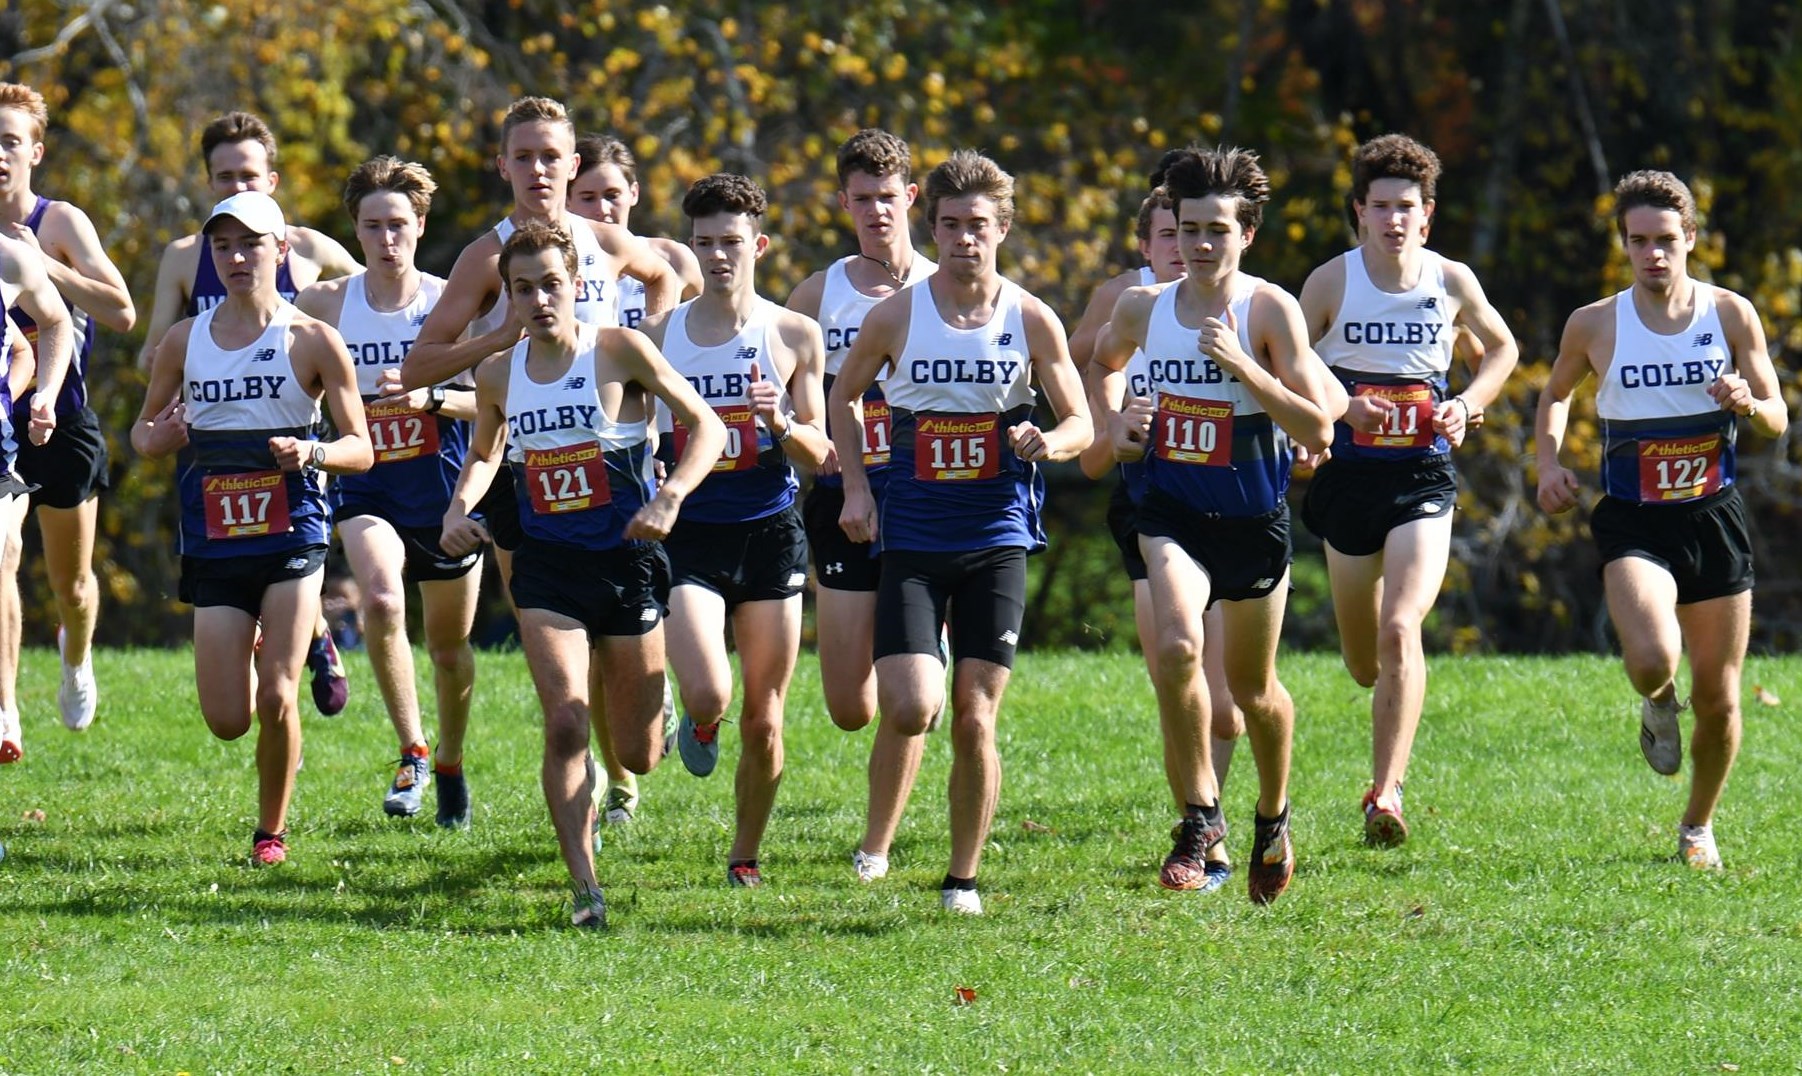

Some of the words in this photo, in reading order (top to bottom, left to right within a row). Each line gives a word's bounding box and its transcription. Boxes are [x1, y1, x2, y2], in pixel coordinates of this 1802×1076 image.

[1344, 322, 1443, 344] COLBY
[911, 359, 1018, 384] COLBY
[1149, 359, 1242, 384] COLB
[1620, 359, 1724, 389] COLBY
[189, 375, 286, 403] COLBY
[370, 417, 425, 450] 112
[508, 405, 597, 438] COLBY
[1165, 417, 1217, 452] 110
[931, 437, 986, 468] 115
[538, 466, 594, 501] 121
[1656, 456, 1708, 489] 122
[220, 491, 272, 525] 117
